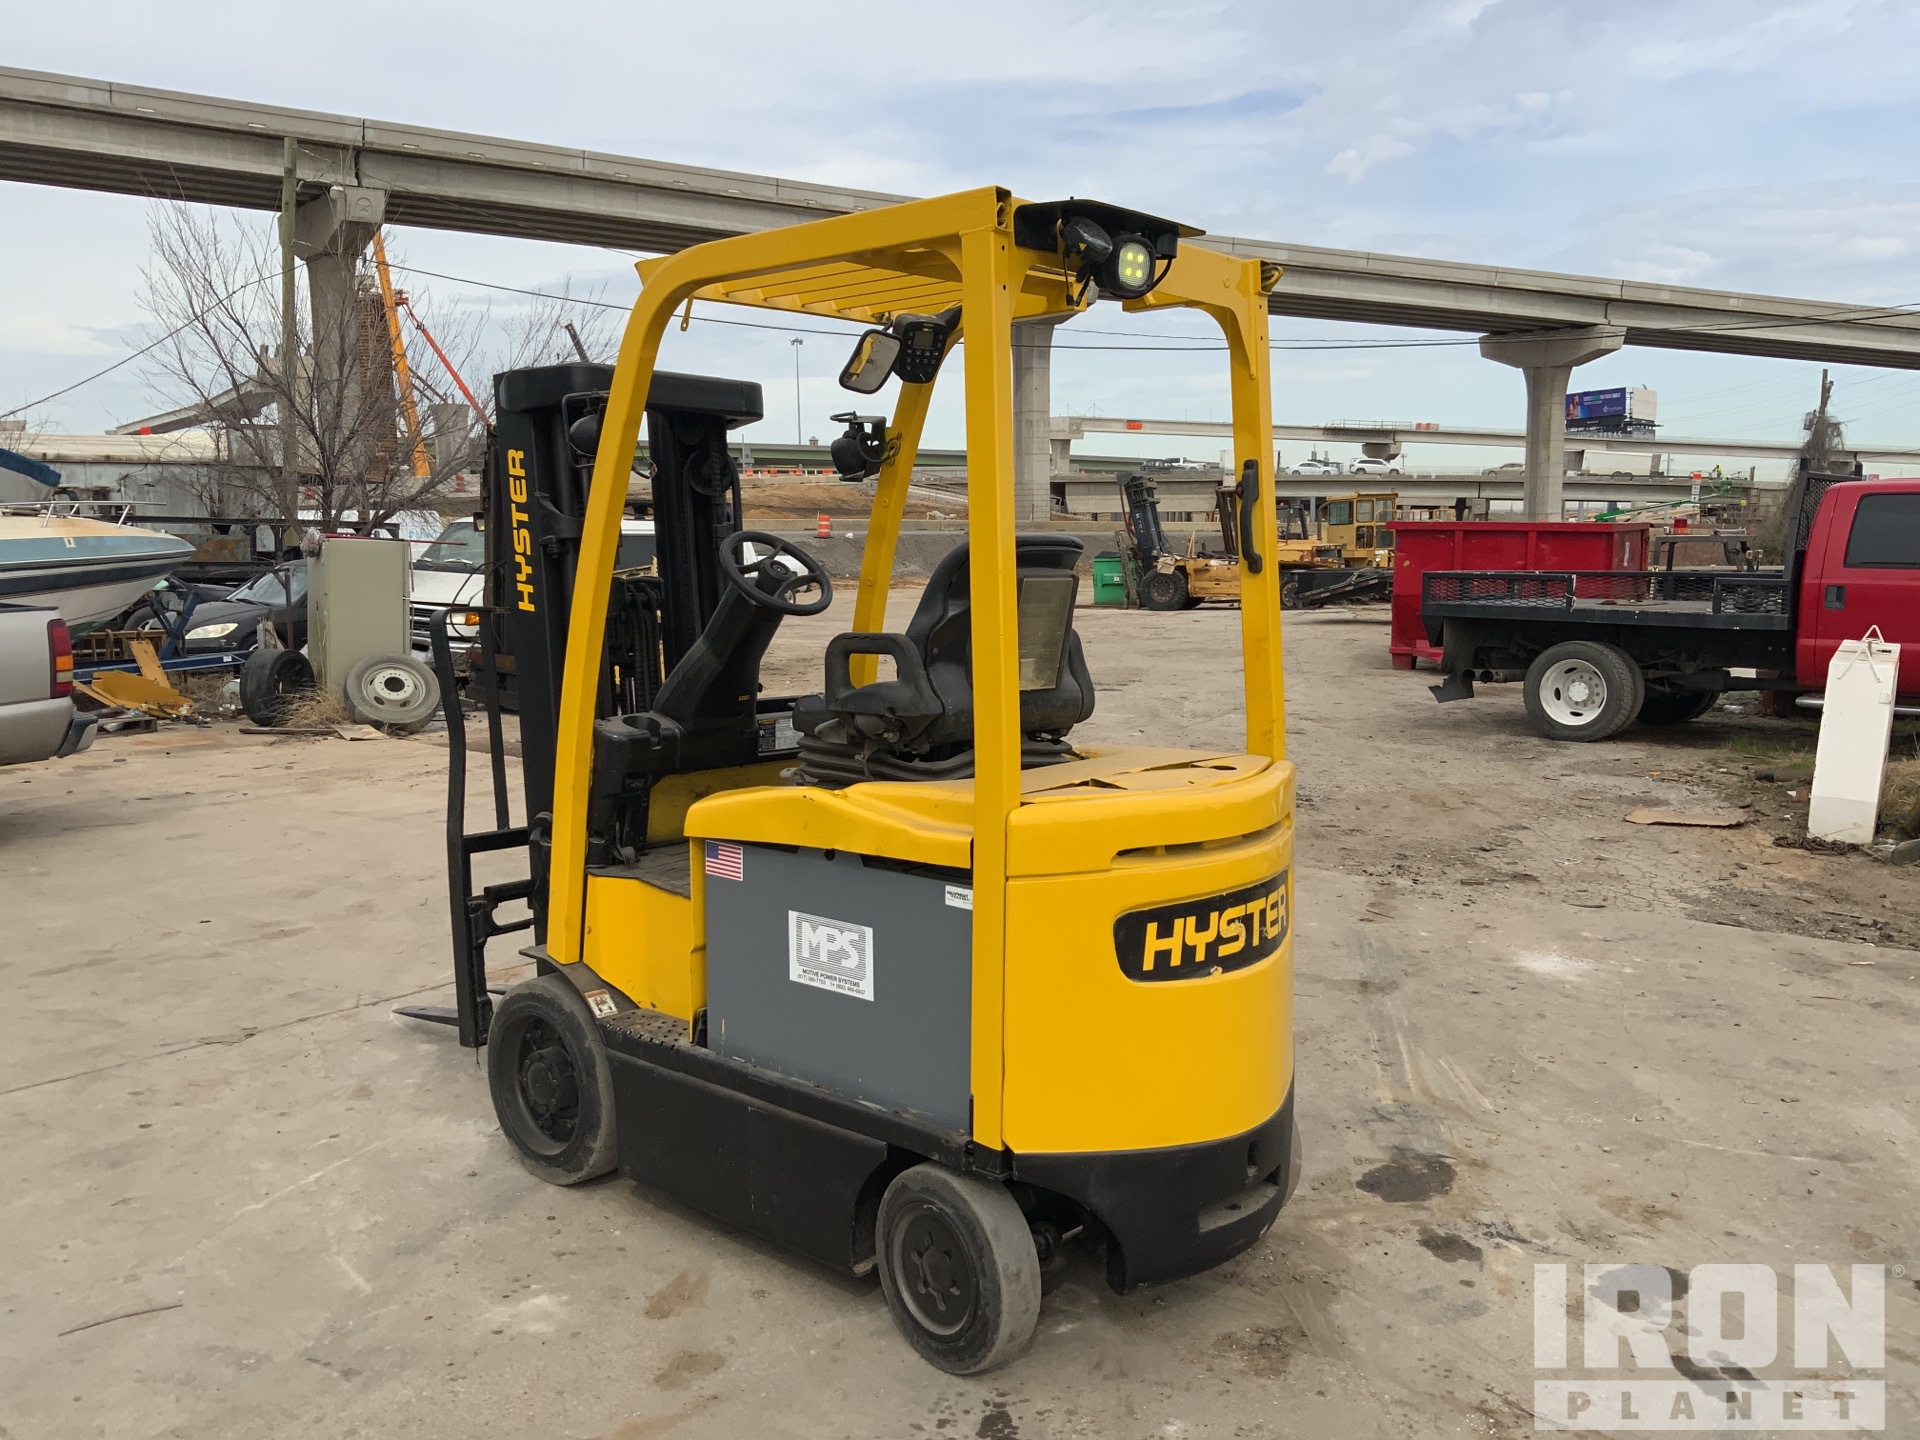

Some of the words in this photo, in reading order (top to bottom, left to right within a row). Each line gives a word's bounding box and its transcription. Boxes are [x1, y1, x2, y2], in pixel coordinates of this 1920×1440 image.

[507, 448, 535, 612] HYSTER
[801, 921, 859, 969] MPS
[1142, 883, 1287, 972] HYSTER
[802, 968, 819, 977] MOTIVE
[820, 973, 837, 982] POWER
[838, 977, 860, 988] SYSTEMS
